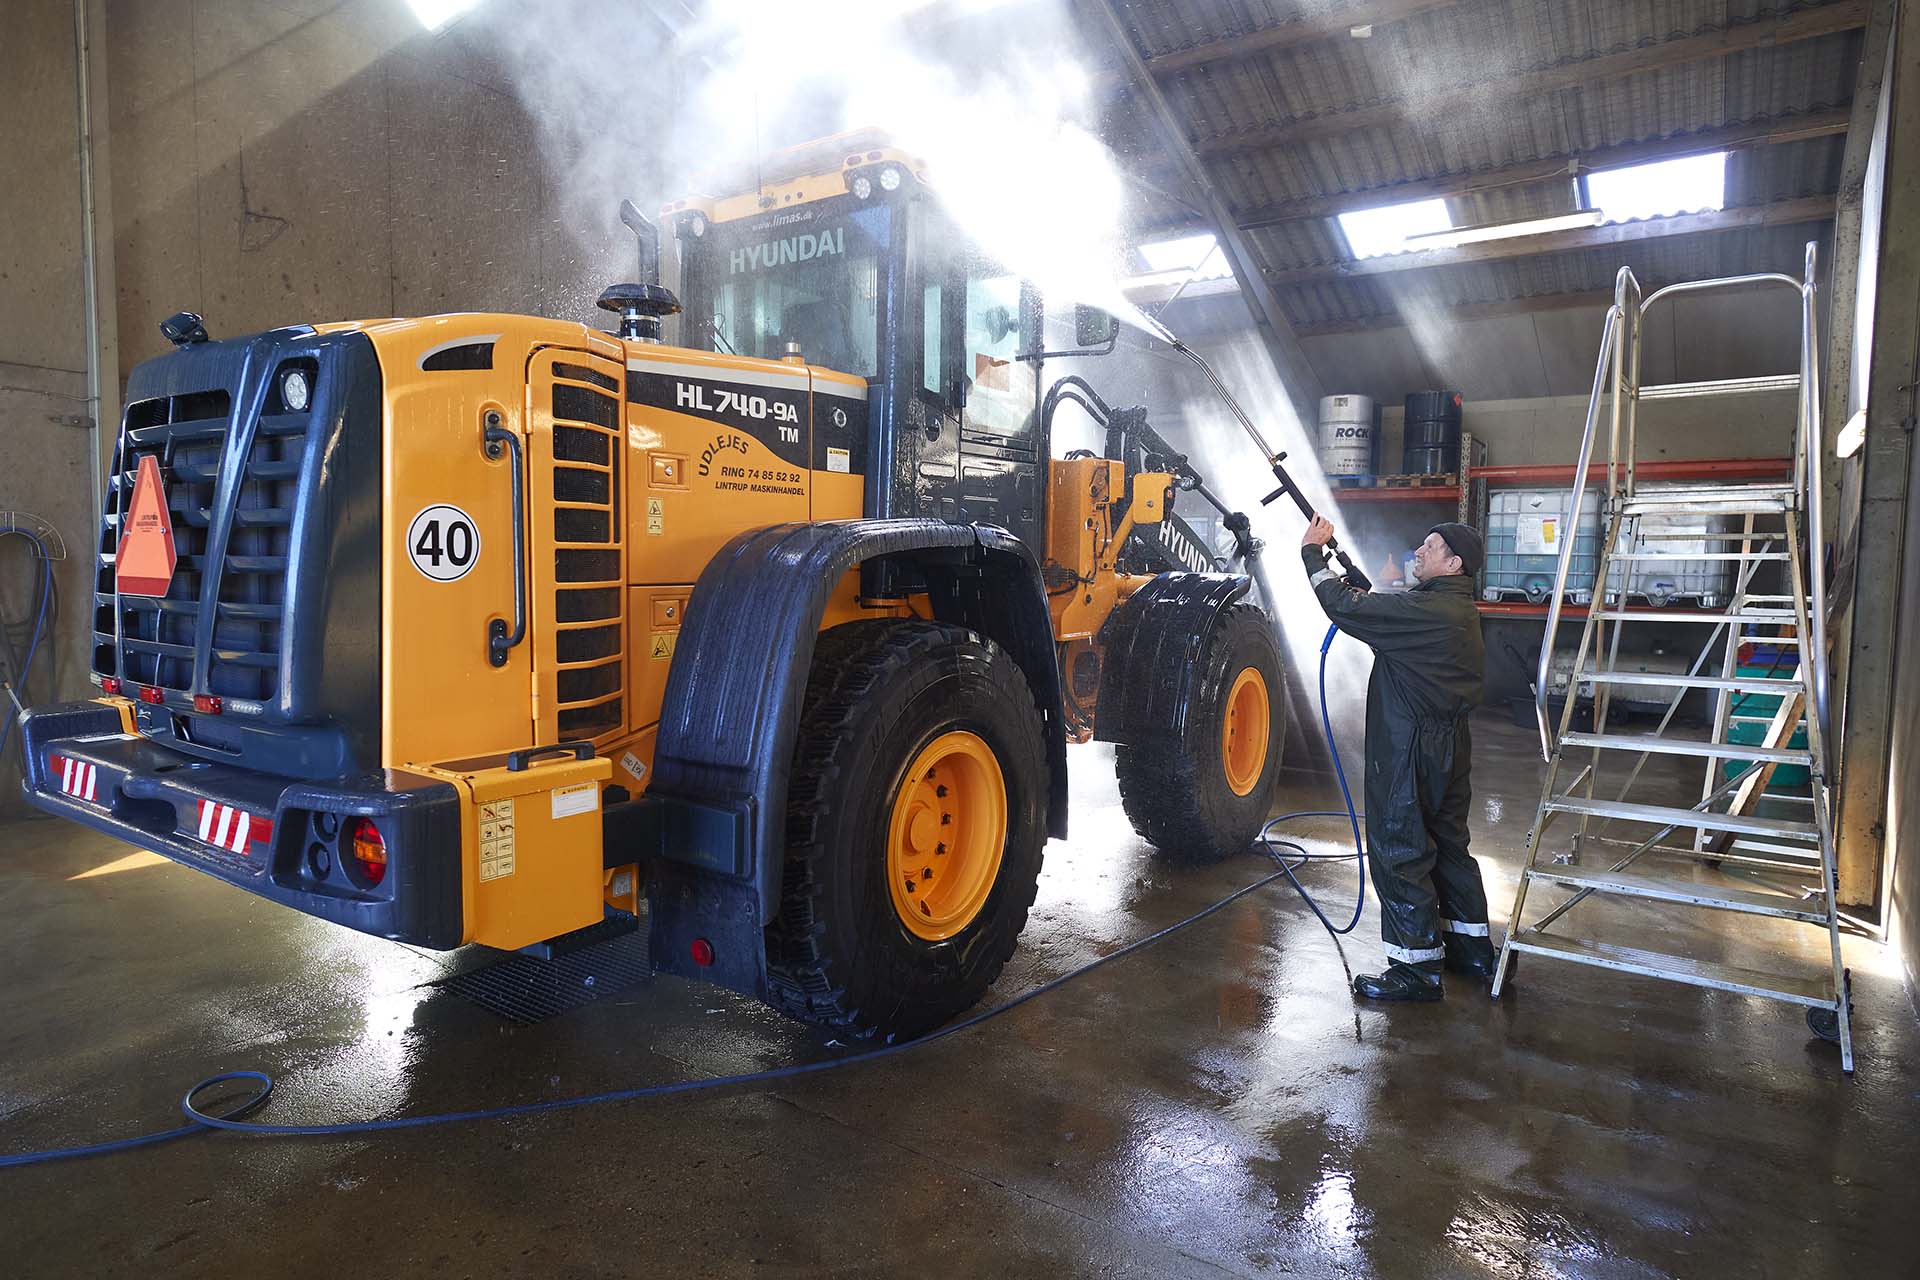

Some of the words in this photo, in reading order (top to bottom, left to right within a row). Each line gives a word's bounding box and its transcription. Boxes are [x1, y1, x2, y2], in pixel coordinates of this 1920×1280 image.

[752, 210, 813, 231] www.limas.dk
[729, 227, 844, 274] HYUNDAI
[778, 426, 799, 443] TM
[1335, 427, 1369, 439] ROCK
[698, 434, 749, 477] UDLEJES
[721, 466, 745, 478] RING
[748, 469, 760, 479] 74
[762, 470, 774, 481] 85
[776, 472, 788, 483] 52
[789, 473, 801, 483] 92
[715, 481, 748, 491] LINTRUP
[750, 484, 805, 496] MASKINHANDEL
[416, 520, 472, 567] 40
[1158, 519, 1219, 573] HYUND
